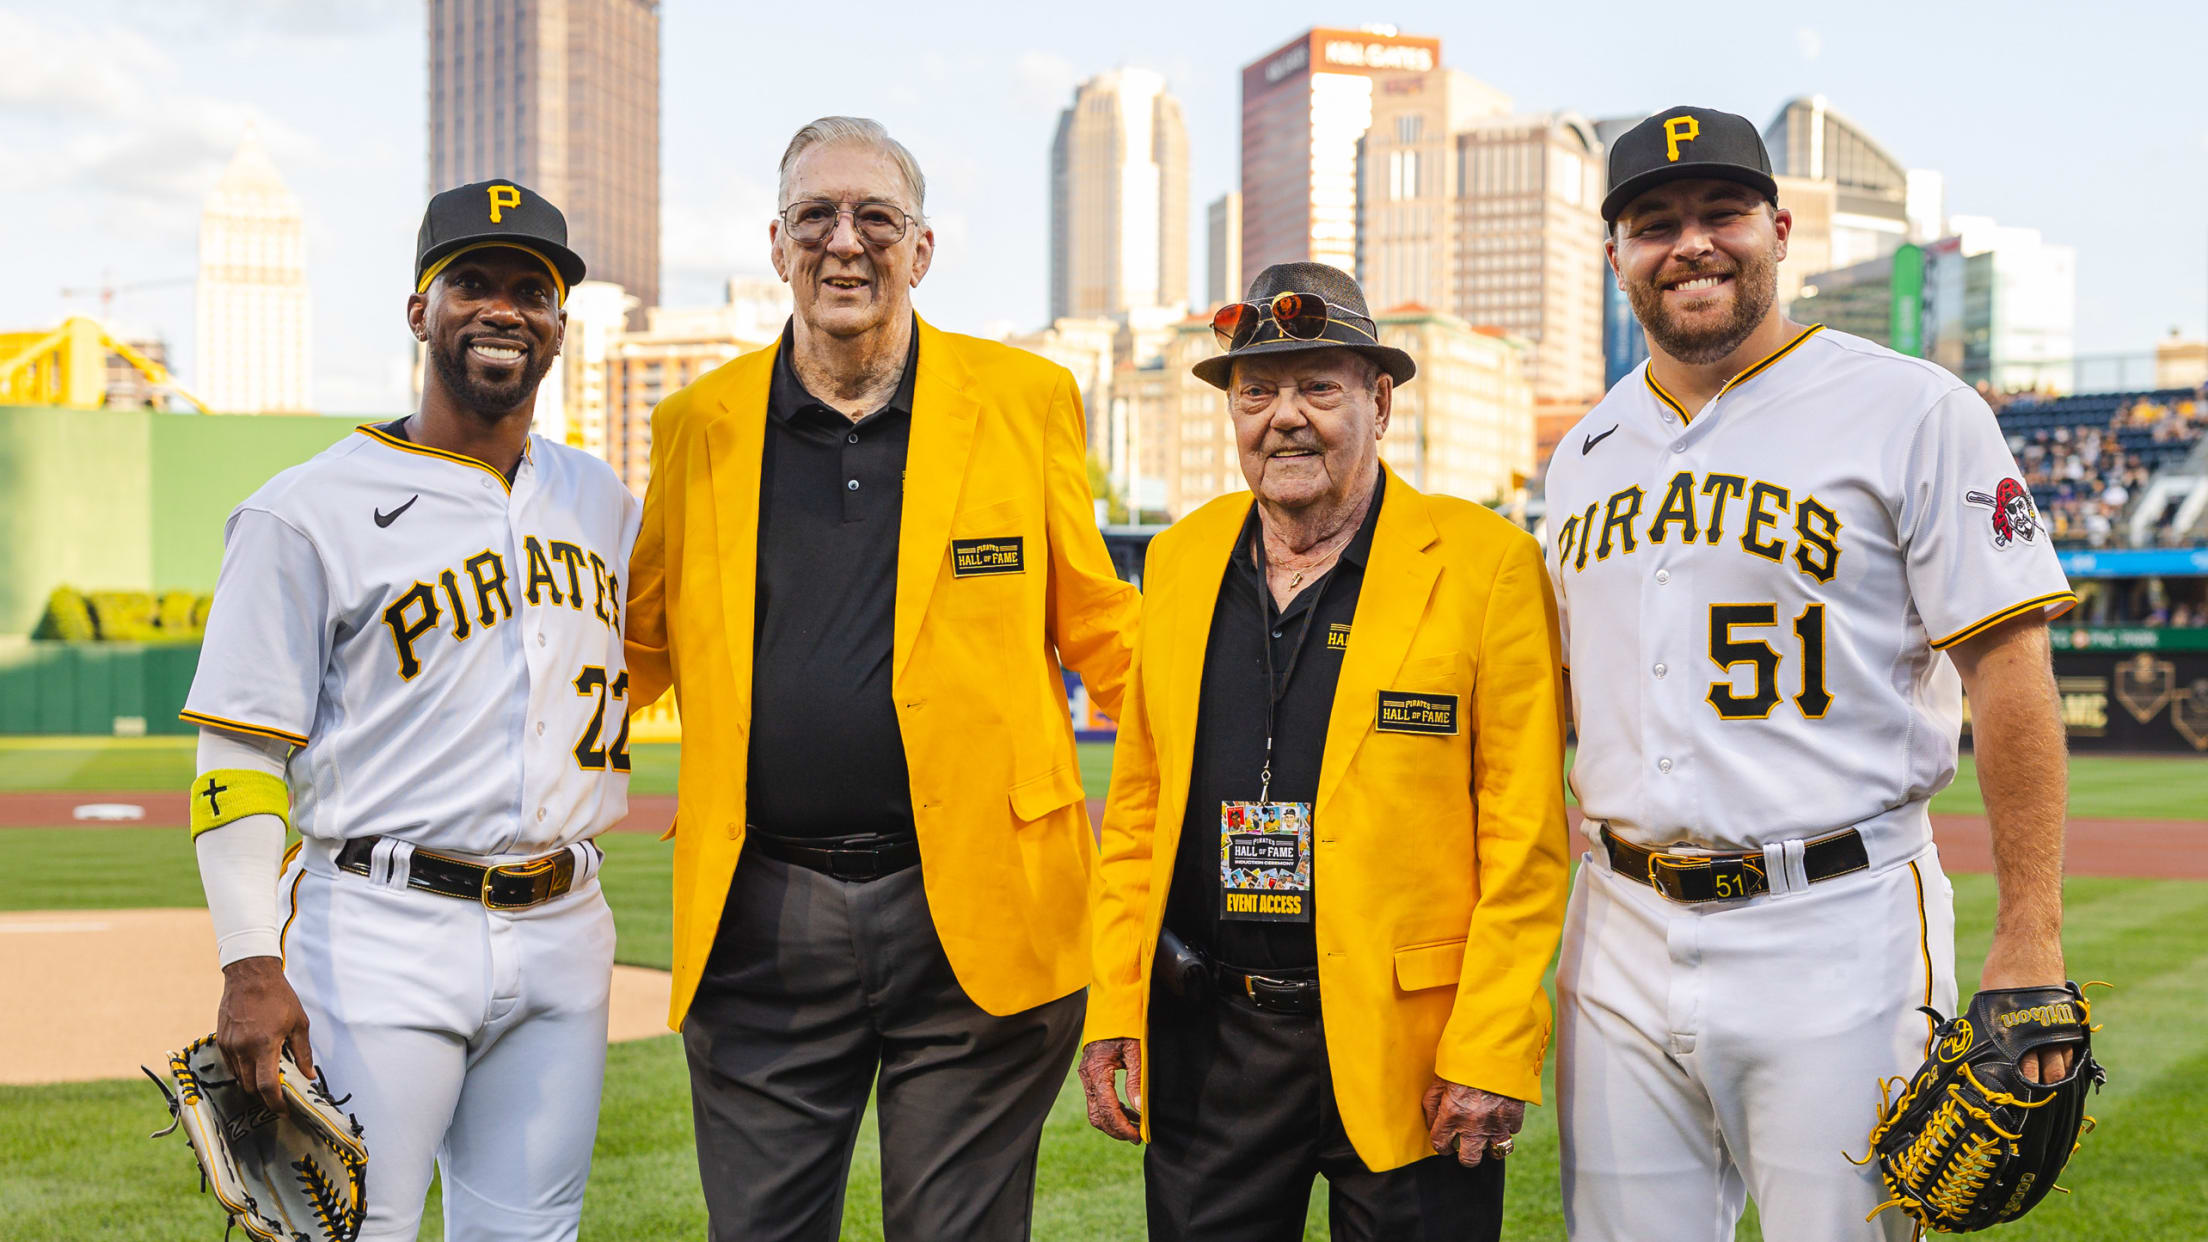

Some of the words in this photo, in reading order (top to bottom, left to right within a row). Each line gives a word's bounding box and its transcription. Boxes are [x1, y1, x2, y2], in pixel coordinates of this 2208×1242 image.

[1663, 115, 1700, 162] P
[487, 185, 521, 224] P
[958, 554, 983, 566] HALL
[983, 555, 992, 563] OF
[992, 552, 1018, 564] FAME
[976, 544, 1000, 554] PIRATES
[1705, 602, 1835, 720] 51
[1405, 700, 1431, 710] PIRATES
[1383, 708, 1410, 721] HALL
[1422, 711, 1450, 724] FAME
[1235, 846, 1257, 857] HALL
[1267, 847, 1294, 858] FAME
[1716, 874, 1744, 898] 51
[1226, 893, 1258, 913] EVENT
[1259, 894, 1302, 914] ACCESS
[2001, 1003, 2077, 1028] Wilson
